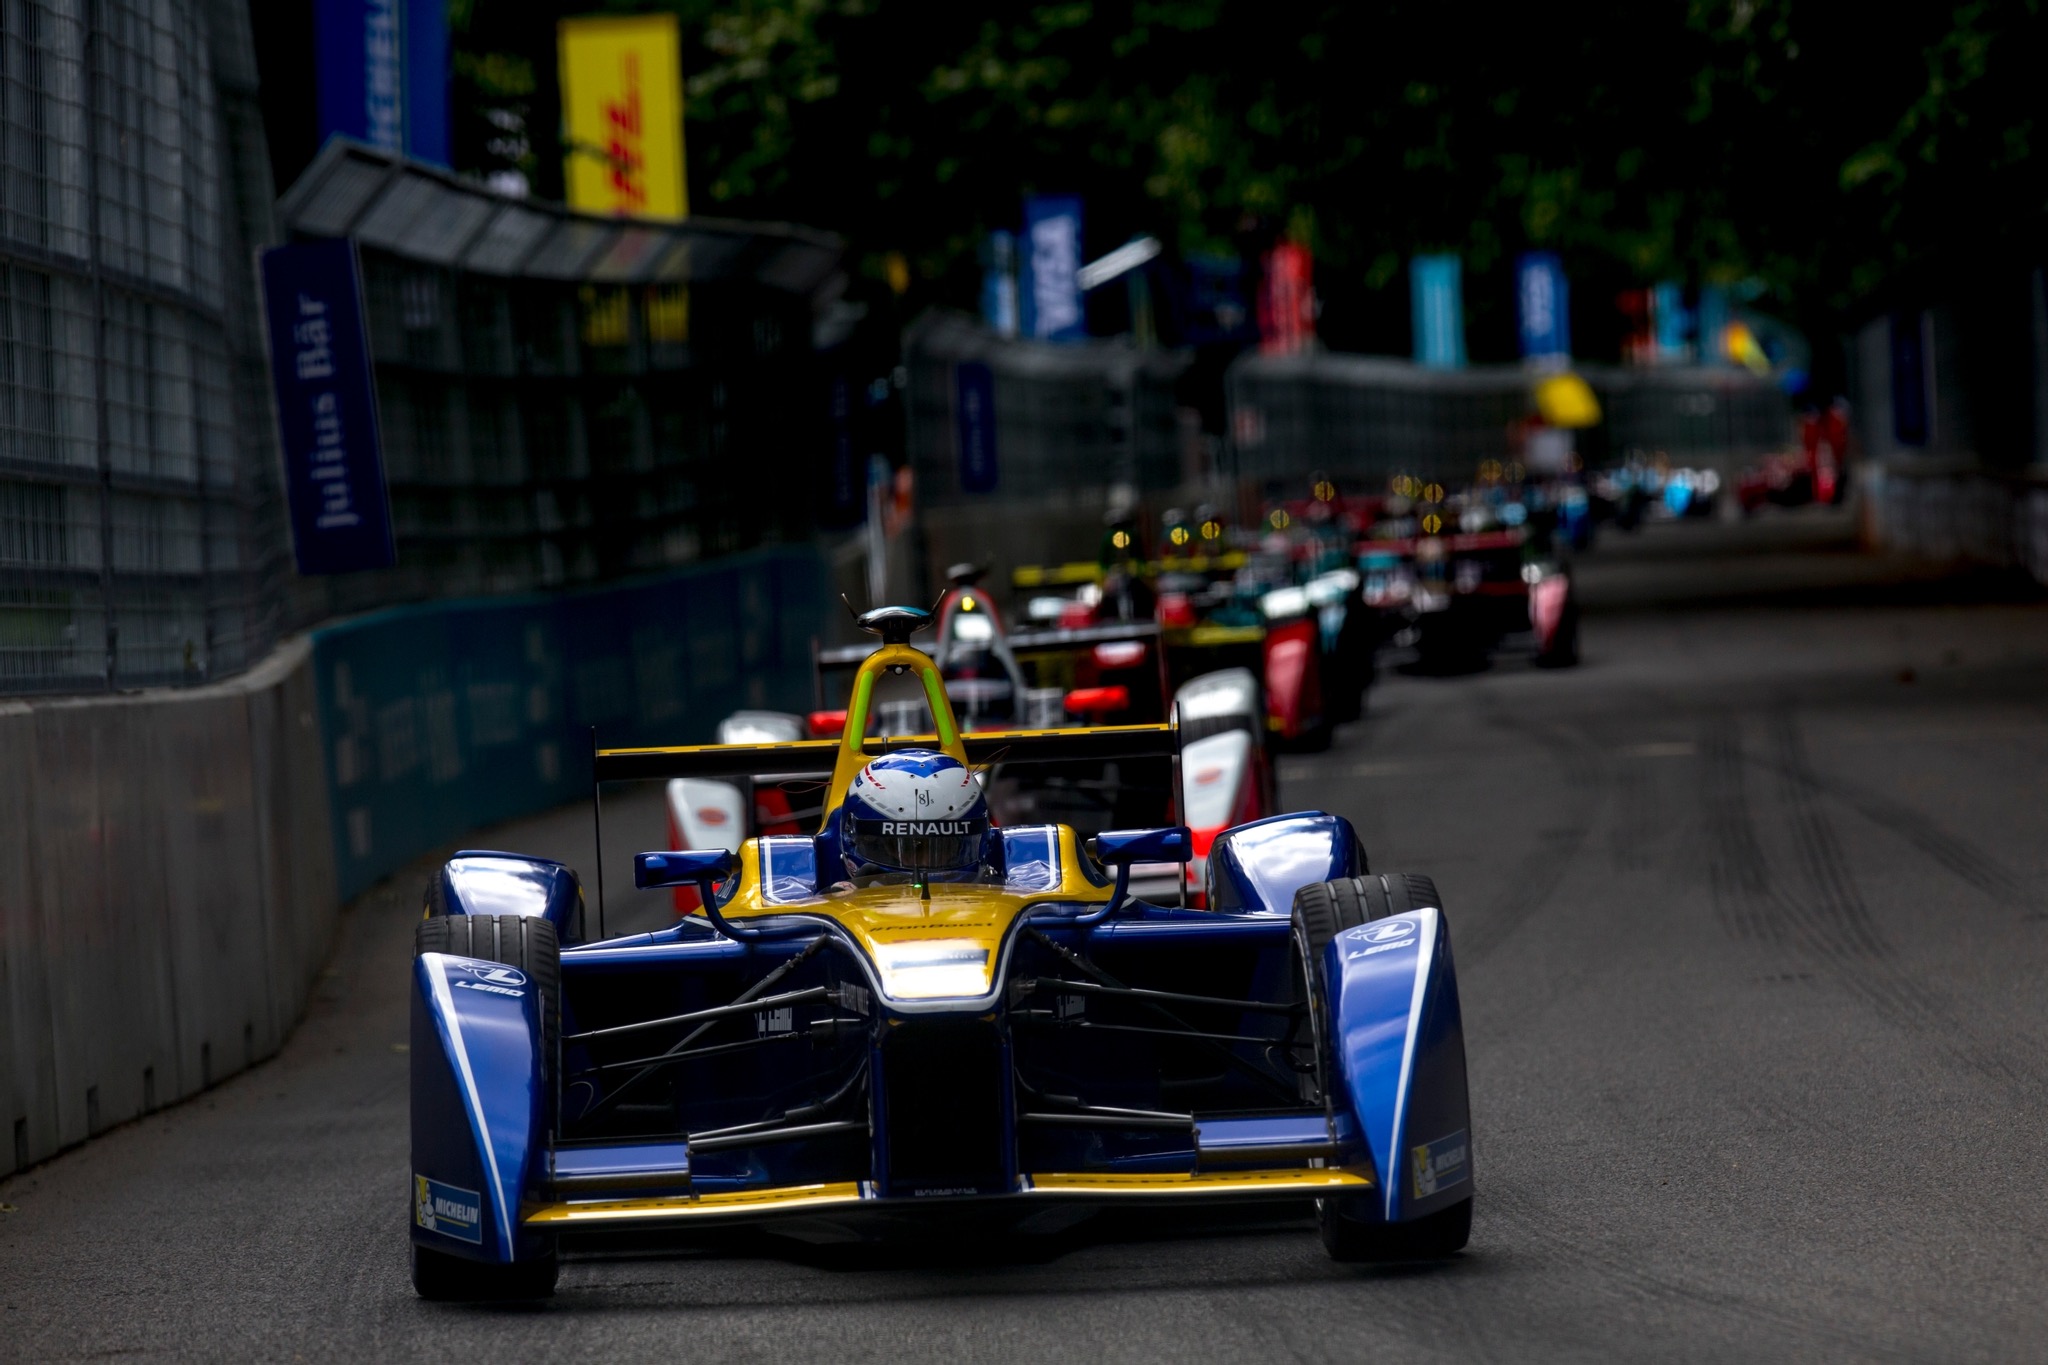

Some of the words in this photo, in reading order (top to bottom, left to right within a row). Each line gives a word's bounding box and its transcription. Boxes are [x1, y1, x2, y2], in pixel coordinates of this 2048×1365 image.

[293, 291, 334, 380] Bär
[309, 391, 362, 529] Julius
[881, 821, 971, 835] RENAULT
[1347, 937, 1417, 960] LEMO
[454, 980, 526, 998] LEMO
[435, 1196, 479, 1225] MICHELIN
